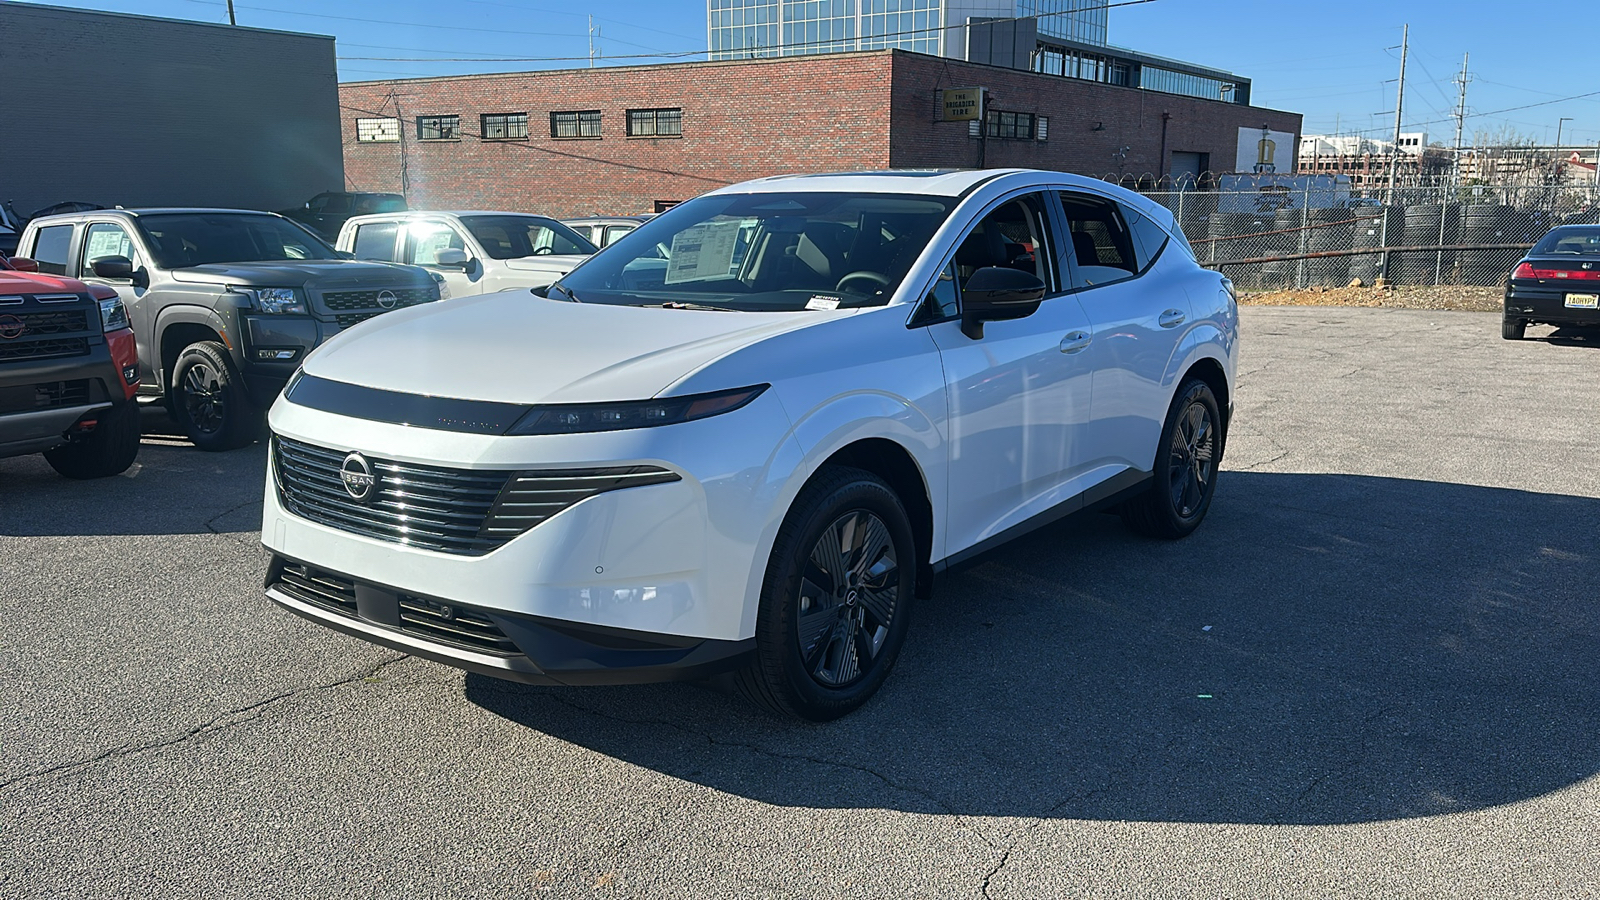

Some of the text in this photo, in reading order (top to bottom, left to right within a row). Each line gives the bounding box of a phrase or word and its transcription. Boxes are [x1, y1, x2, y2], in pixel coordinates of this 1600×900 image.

[946, 100, 976, 109] BRIGADIER
[952, 108, 969, 116] TIRE
[340, 470, 374, 486] NISSAN
